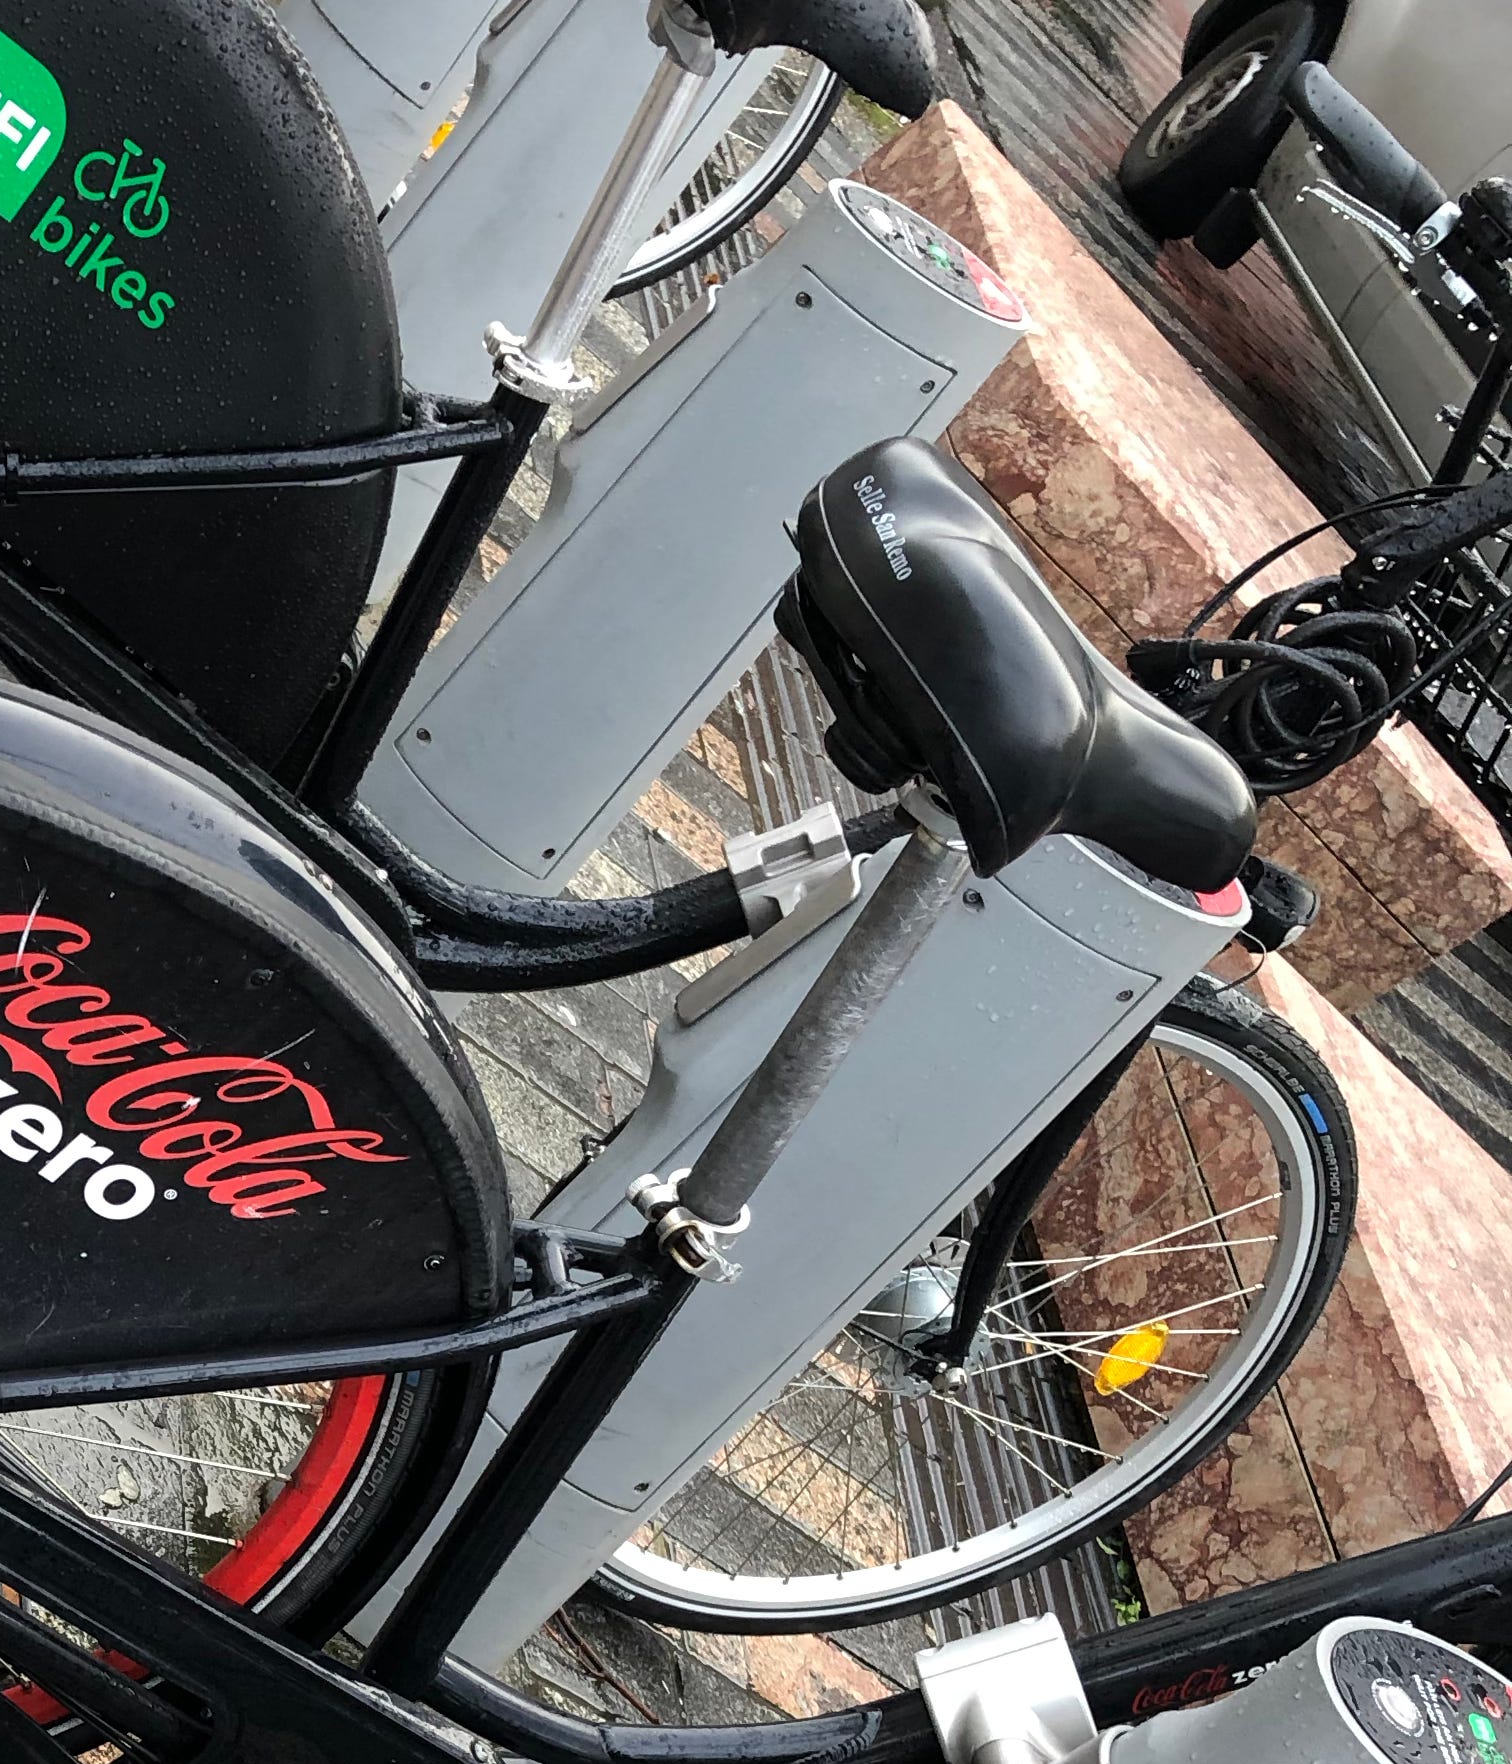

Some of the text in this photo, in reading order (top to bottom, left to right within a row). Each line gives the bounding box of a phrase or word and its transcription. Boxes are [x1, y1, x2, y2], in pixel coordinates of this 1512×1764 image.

[29, 196, 176, 330] bikes
[853, 474, 913, 581] Selle San Remo
[1328, 1201, 1341, 1234] PLUS
[363, 1389, 415, 1497] MARATHON
[1231, 1659, 1282, 1685] zer
